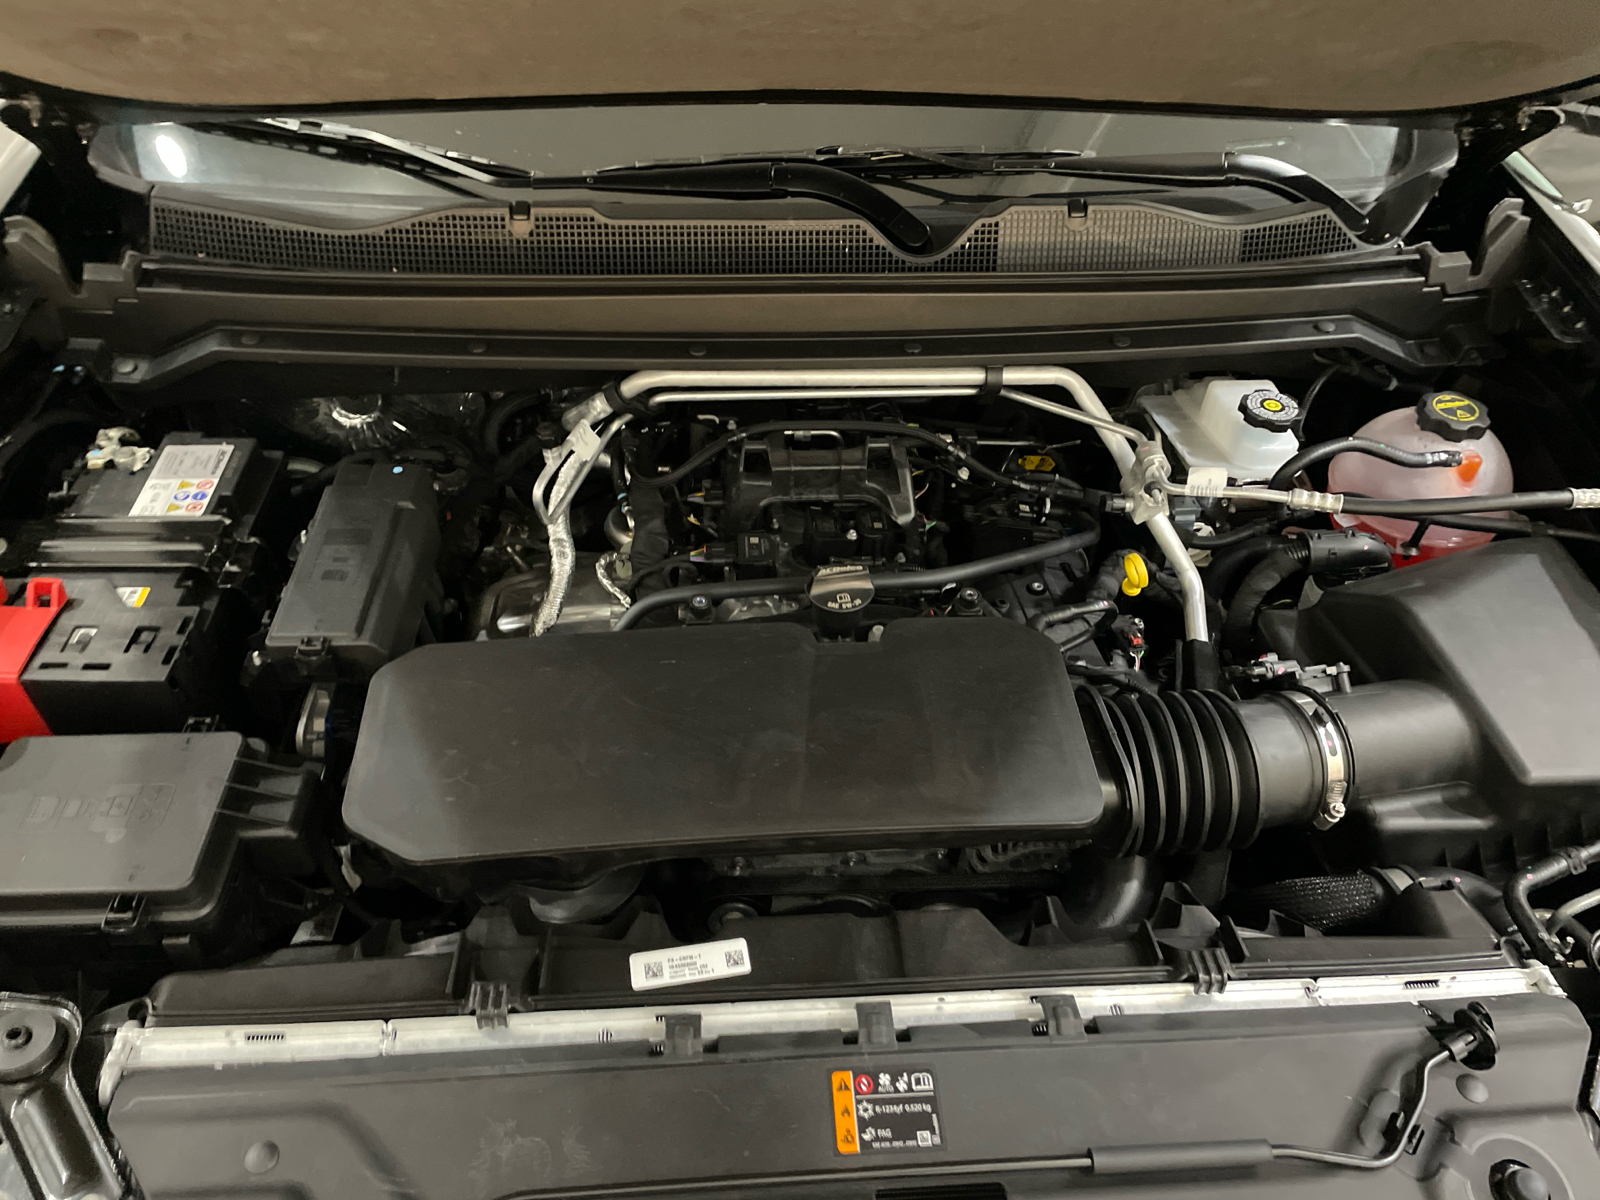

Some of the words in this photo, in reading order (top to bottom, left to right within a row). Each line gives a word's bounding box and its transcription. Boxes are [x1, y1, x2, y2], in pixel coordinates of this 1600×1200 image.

[816, 565, 863, 577] ACDelco
[827, 601, 839, 609] SAE
[878, 1085, 894, 1093] AUTO
[875, 1103, 903, 1115] R-1234yf
[904, 1103, 922, 1113] 0.520
[923, 1102, 932, 1113] kg
[877, 1128, 892, 1139] PAG
